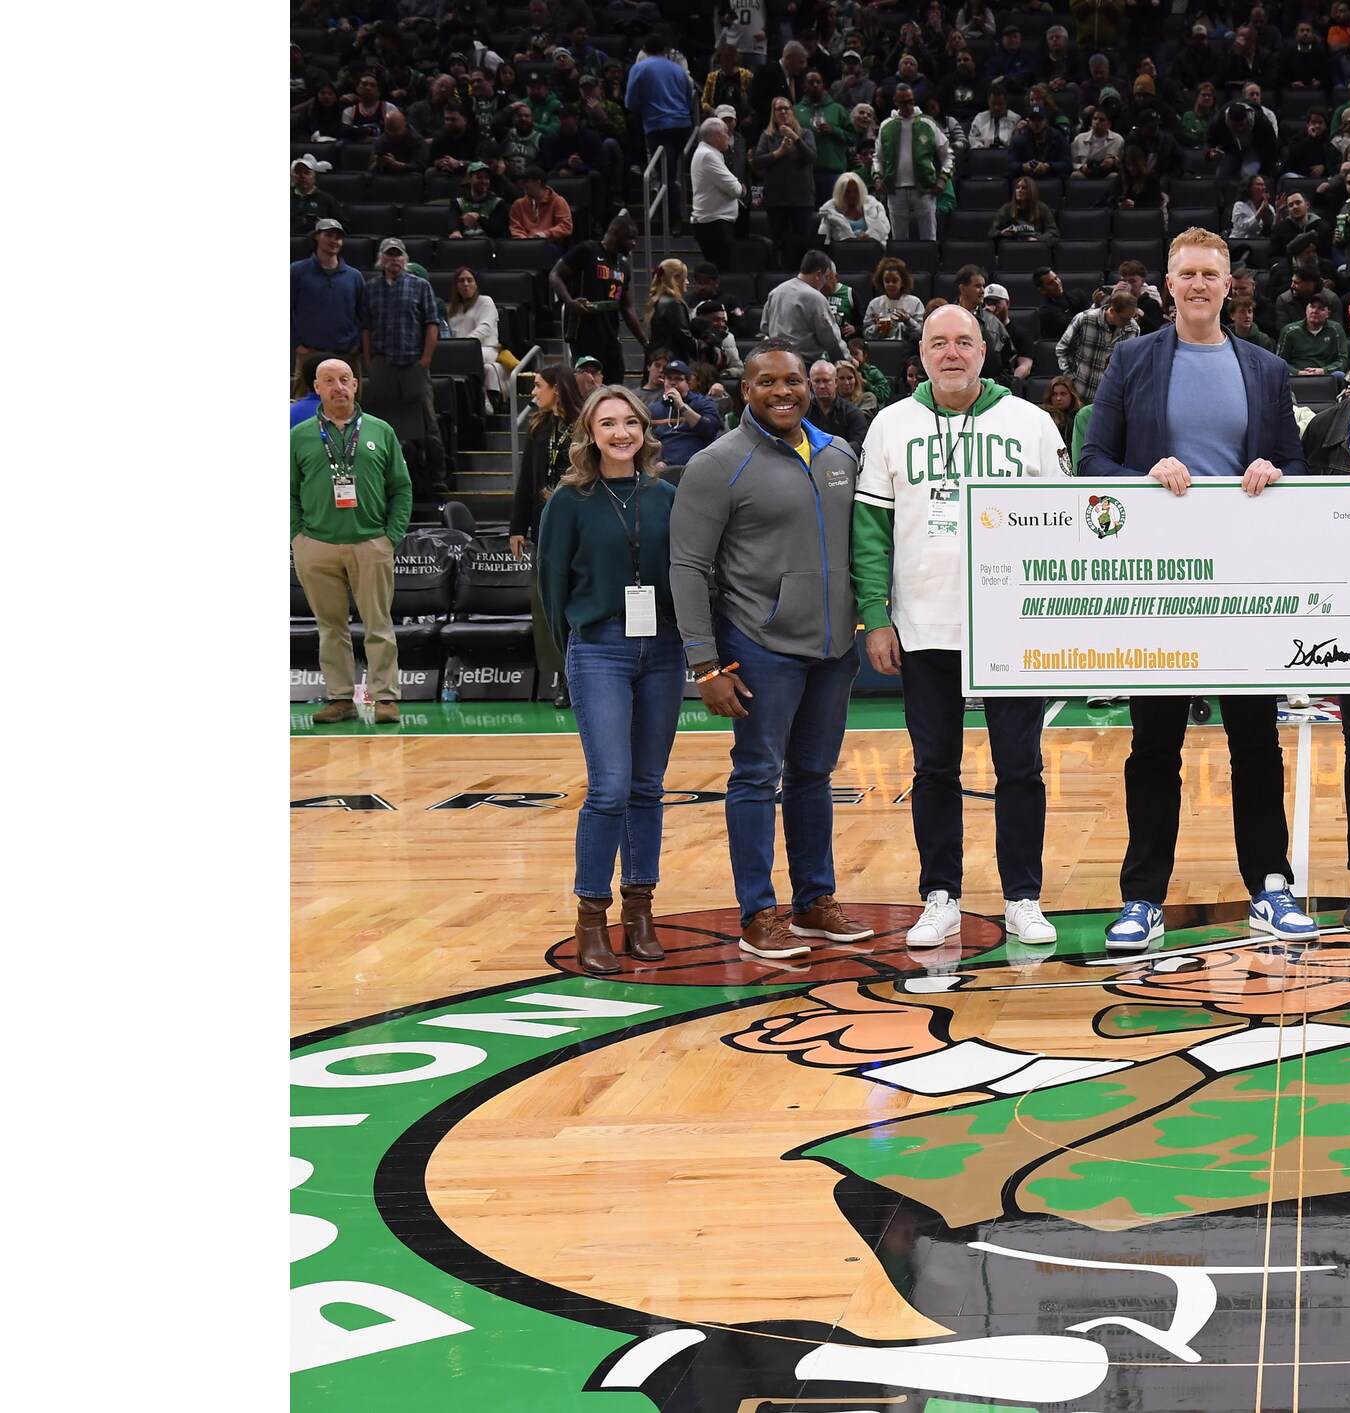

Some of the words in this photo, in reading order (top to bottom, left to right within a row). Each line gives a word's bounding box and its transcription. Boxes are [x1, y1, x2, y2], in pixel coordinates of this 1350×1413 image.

[907, 432, 1023, 486] CELTICS
[1008, 512, 1038, 526] Sun
[1044, 511, 1073, 526] Life
[395, 556, 436, 564] ANKLIN
[476, 553, 531, 561] FRANKLN
[394, 565, 441, 574] MPLETON
[980, 564, 992, 576] Pay
[993, 565, 999, 574] to
[999, 564, 1012, 574] the
[1022, 560, 1067, 581] YMCA
[1071, 560, 1088, 581] OF
[1091, 559, 1153, 581] GREATER
[1157, 558, 1214, 581] BOSTON
[981, 577, 1001, 586] Order
[1021, 598, 1046, 616] ONE
[1046, 598, 1101, 616] HUNDRED
[1103, 597, 1129, 615] AND
[1130, 597, 1156, 615] FIVE
[1158, 596, 1221, 615] THOUSAND
[1220, 596, 1273, 614] DOLLARS
[1273, 596, 1299, 614] AND
[1023, 648, 1199, 670] #SunLifeDunk4Diabetes
[290, 669, 326, 685] Blue
[457, 667, 521, 686] jetBlue
